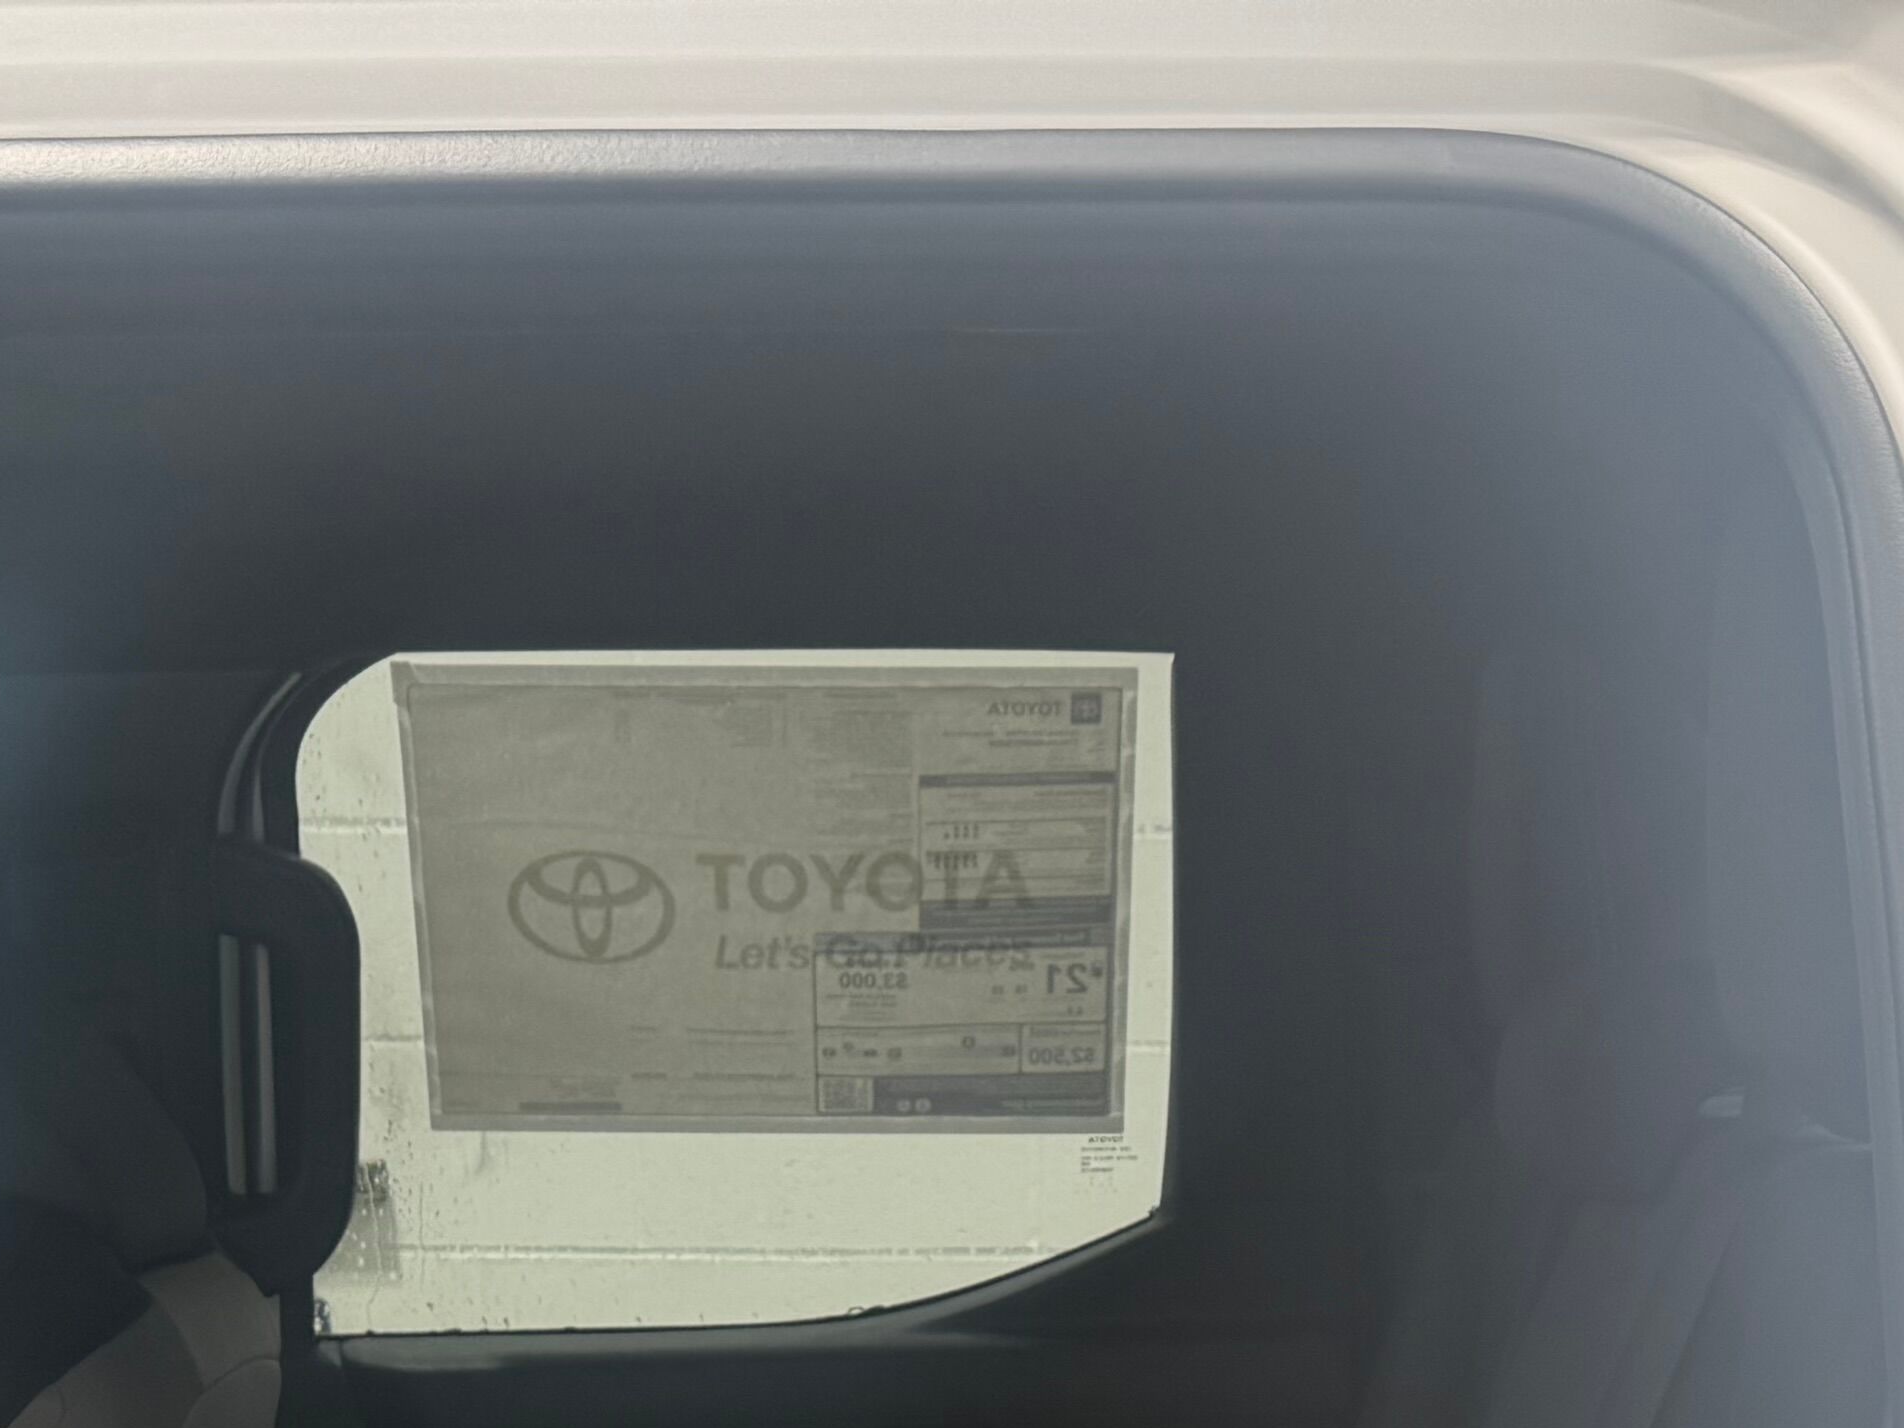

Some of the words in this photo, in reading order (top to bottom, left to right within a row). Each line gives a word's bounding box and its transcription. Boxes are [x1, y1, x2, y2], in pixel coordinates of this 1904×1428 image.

[695, 849, 1037, 914] TOYOTA
[713, 932, 811, 971] Let's
[825, 932, 883, 971] Go
[894, 932, 1035, 972] Places
